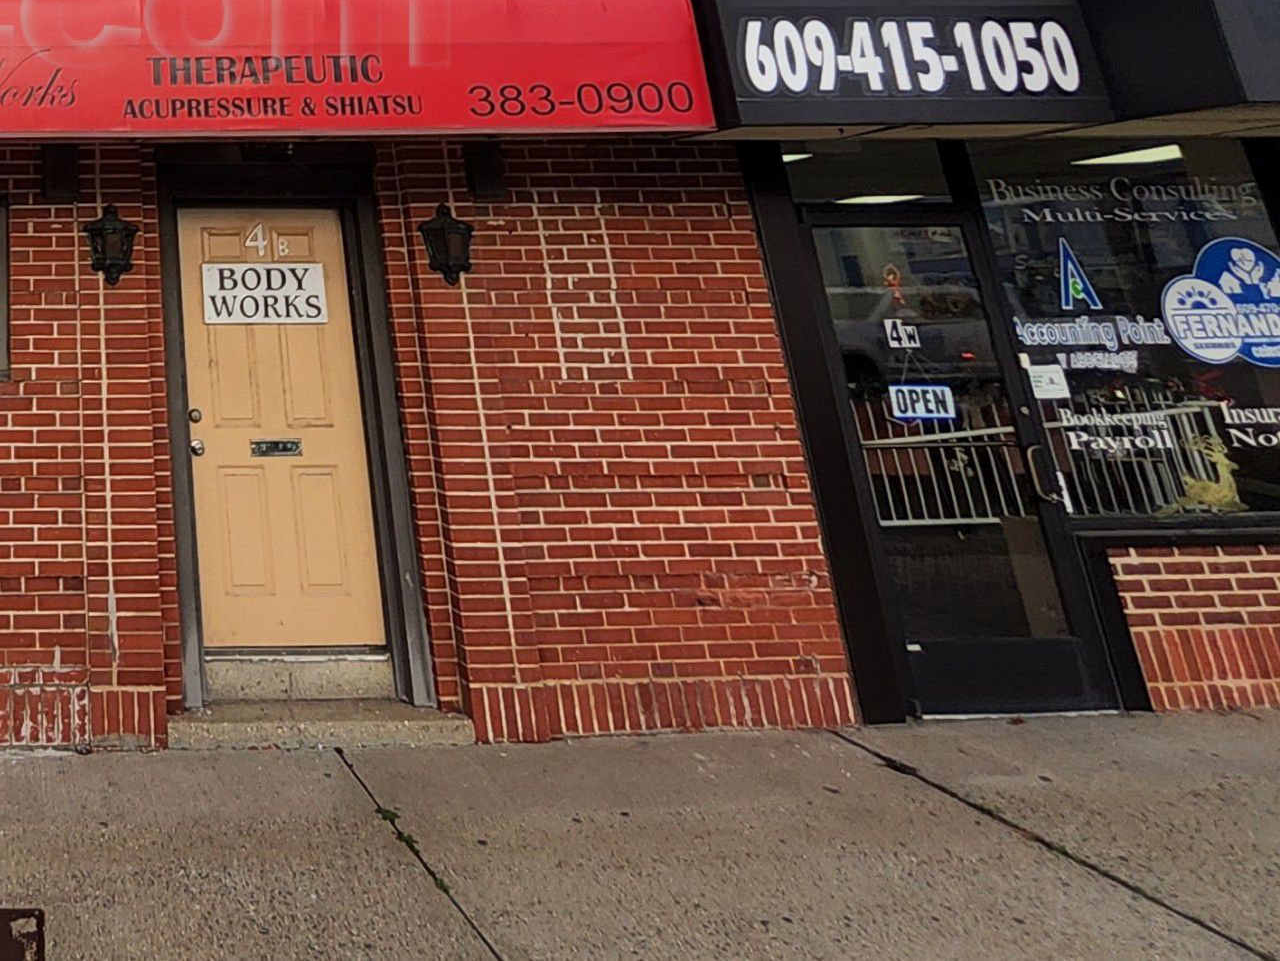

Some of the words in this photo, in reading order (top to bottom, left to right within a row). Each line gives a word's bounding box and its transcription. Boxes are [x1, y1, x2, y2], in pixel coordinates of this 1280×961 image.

[744, 19, 1080, 94] 609-415-1050
[145, 53, 384, 88] THERAPEUTIC
[122, 95, 294, 120] ACUPRESSURE
[300, 96, 317, 118] &
[323, 93, 423, 117] SHIATSU
[467, 80, 695, 118] 383-0900
[986, 178, 1104, 204] Business
[1109, 176, 1260, 206] Consulting
[217, 267, 311, 292] BODY
[208, 294, 322, 319] WORKS
[1013, 315, 1119, 352] Accounting
[894, 388, 950, 414] OPEN
[1220, 401, 1280, 425] Insur
[1057, 407, 1169, 429] Bookkeeping
[1066, 428, 1174, 454] Payroll
[1225, 427, 1280, 448] No
